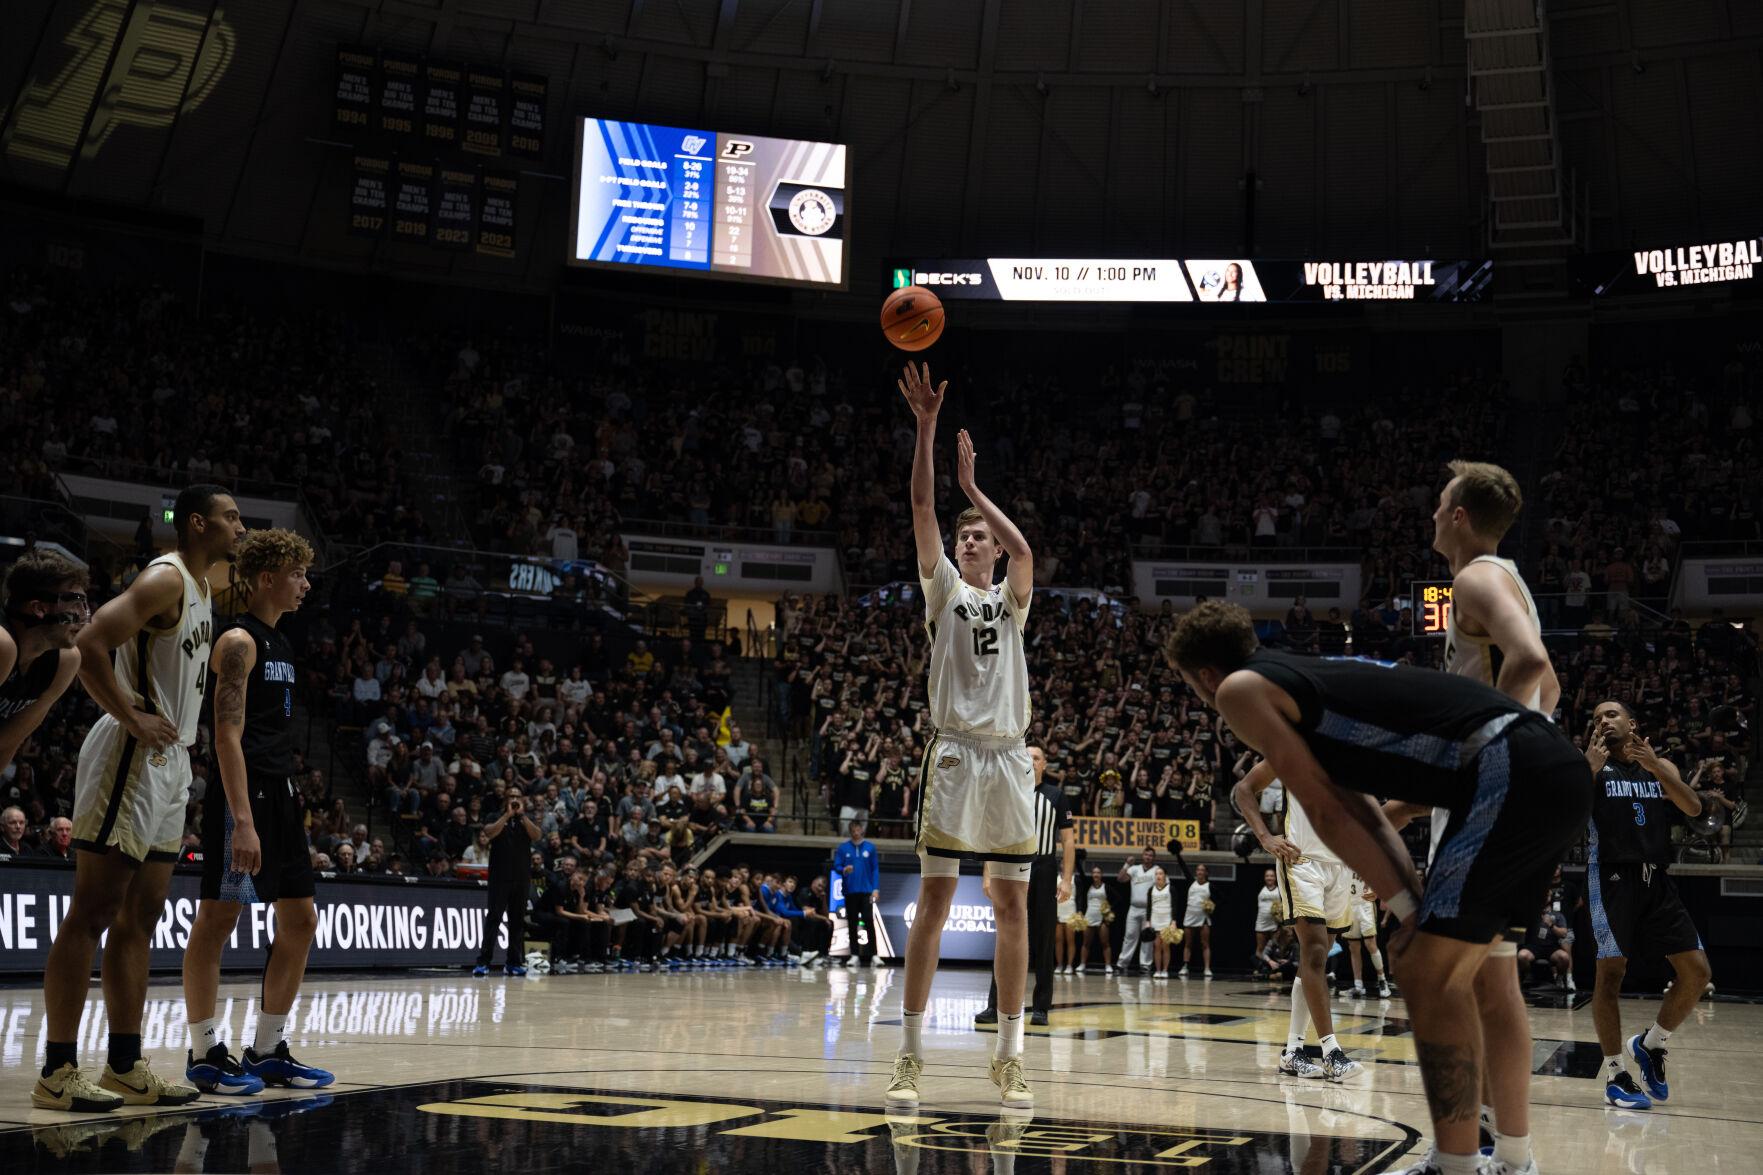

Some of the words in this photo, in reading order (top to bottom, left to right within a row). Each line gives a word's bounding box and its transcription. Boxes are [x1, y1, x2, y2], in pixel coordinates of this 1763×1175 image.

[337, 91, 370, 103] CHAMPS
[382, 99, 414, 111] CHAMPS
[425, 106, 457, 118] CHAMPS
[337, 109, 367, 125] 1994
[468, 112, 499, 125] CHAMPS
[511, 118, 543, 130] CHAMPS
[352, 196, 386, 208] CHAMPS
[396, 201, 429, 213] CHAMPS
[352, 215, 383, 230] 2017
[438, 209, 471, 221] CHAMPS
[482, 214, 513, 226] CHAMPS
[1634, 239, 1762, 275] VOLLEYBAL
[915, 273, 982, 285] BECK'S
[1013, 266, 1048, 281] NOV.
[1056, 266, 1070, 281] 10
[1097, 267, 1126, 282] 1:00
[1133, 267, 1156, 281] PM
[1304, 262, 1435, 285] VOLLEYBALL
[1656, 272, 1678, 287] VS.
[1680, 264, 1753, 285] MICHIGAN
[1323, 285, 1344, 299] VS.
[1346, 285, 1414, 299] MICHIGAN
[645, 309, 718, 335] PAINT
[1216, 335, 1291, 359] PAINT
[1216, 359, 1289, 383] CREW
[1424, 586, 1454, 602] 18:4
[973, 627, 999, 656] 12
[196, 661, 205, 695] 4
[1633, 802, 1645, 826] 3
[1073, 820, 1135, 846] FENSE
[1136, 822, 1165, 834] LIVES
[1186, 824, 1196, 838] 8
[1136, 835, 1165, 847] HERE
[313, 903, 427, 950] WORKING
